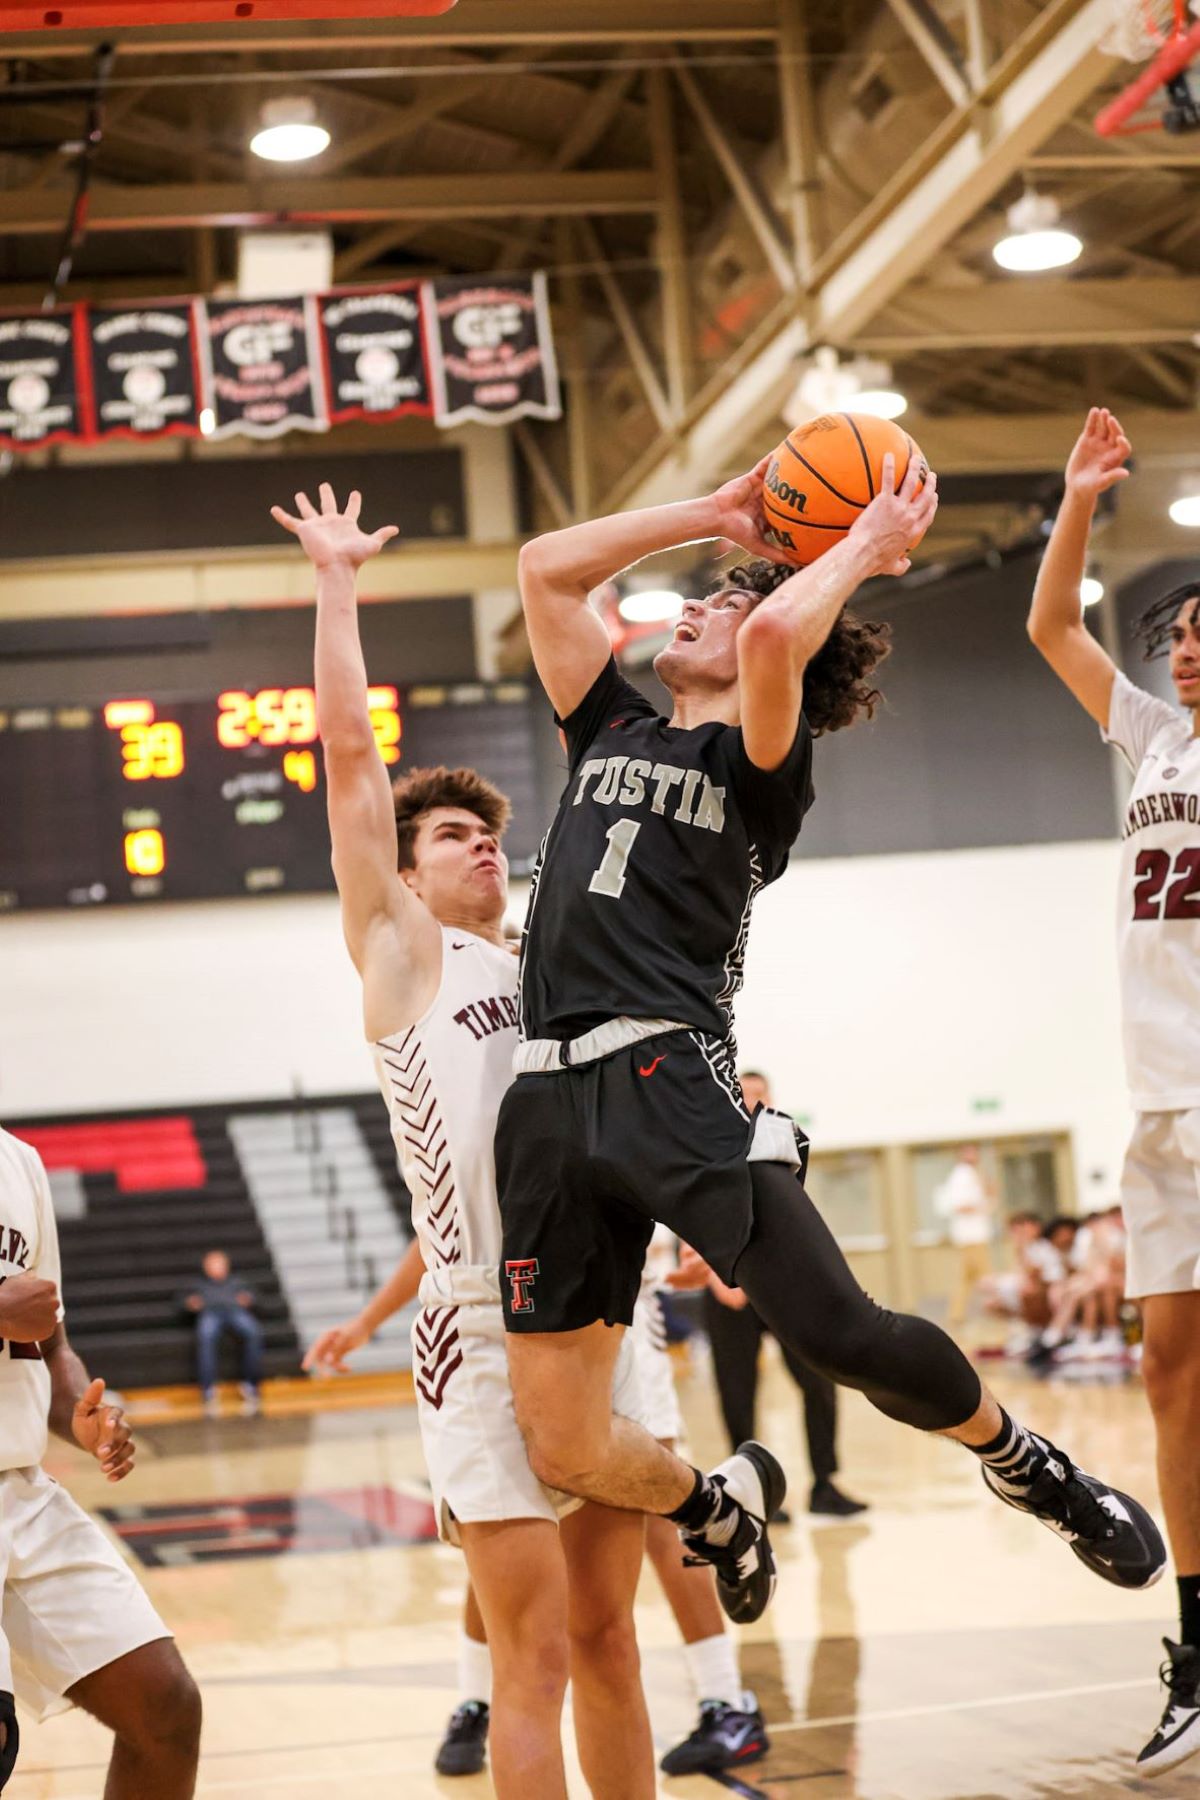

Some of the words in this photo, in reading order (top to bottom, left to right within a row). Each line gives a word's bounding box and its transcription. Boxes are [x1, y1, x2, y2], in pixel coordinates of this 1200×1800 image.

[119, 721, 184, 780] 39
[217, 688, 317, 747] 2:59
[283, 750, 316, 792] 4
[573, 756, 726, 834] TUSTIN
[588, 818, 642, 900] 1
[1132, 848, 1200, 921] 22
